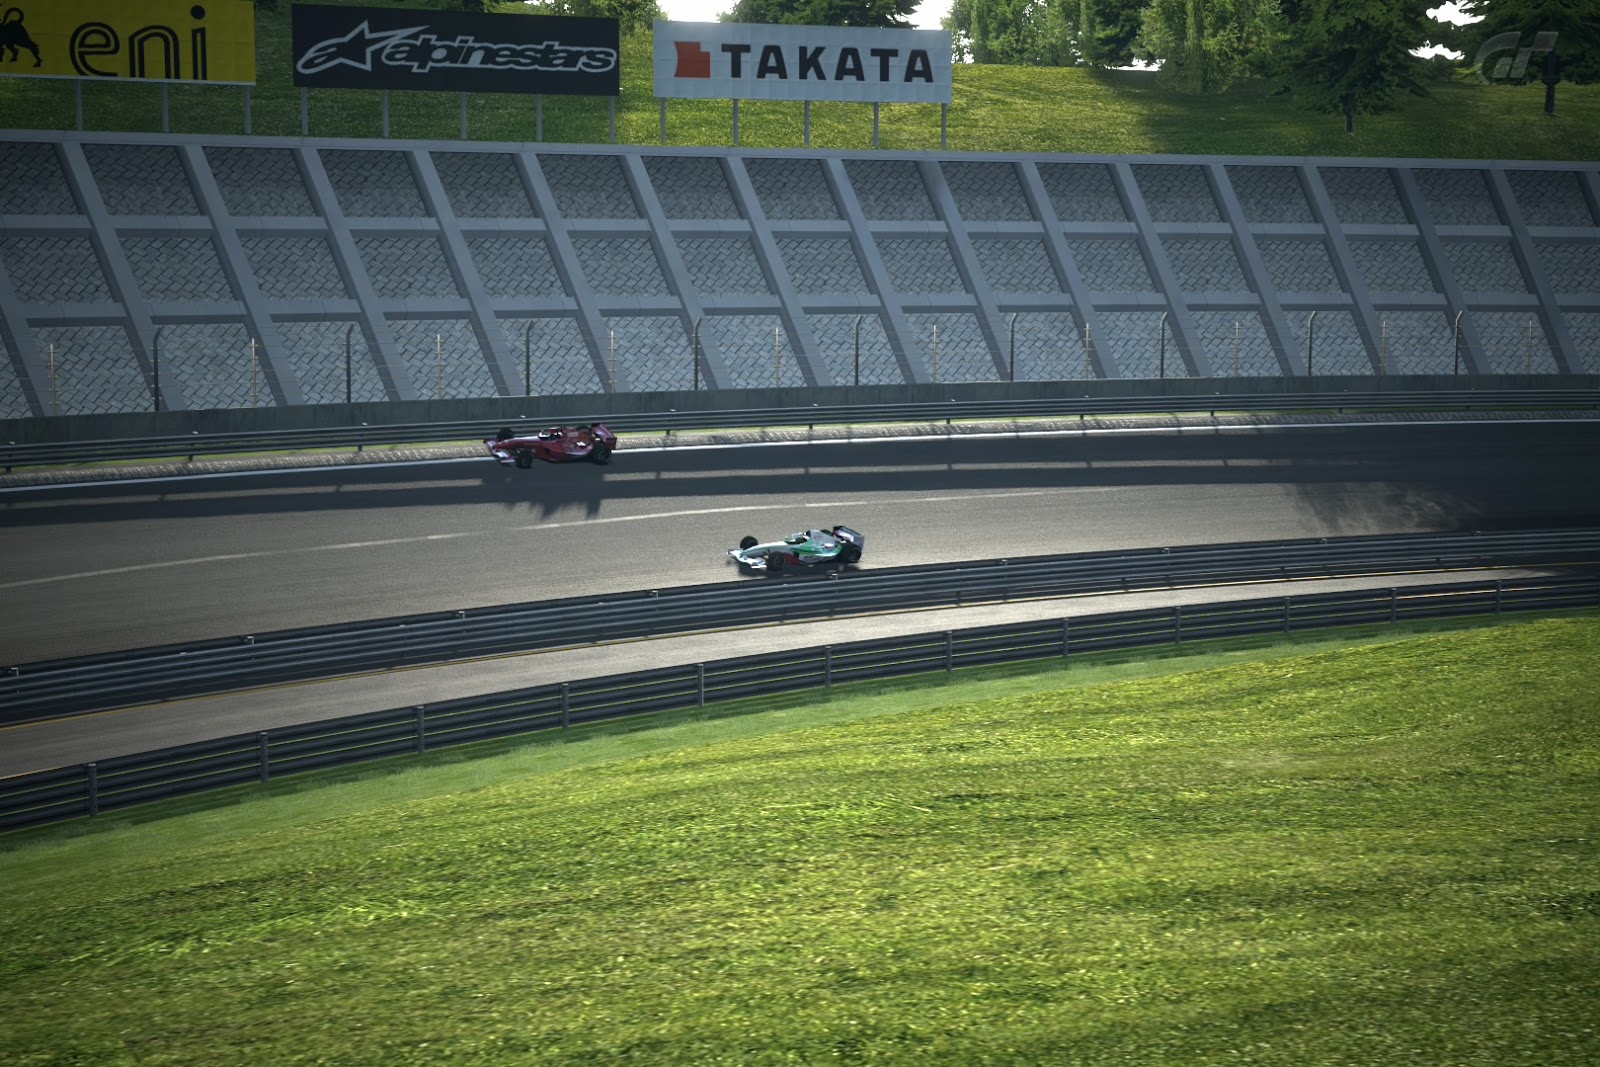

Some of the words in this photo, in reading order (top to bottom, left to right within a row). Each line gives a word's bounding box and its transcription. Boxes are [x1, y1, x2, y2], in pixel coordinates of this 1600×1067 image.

[69, 4, 208, 80] eni
[386, 33, 617, 74] alpinestars
[720, 43, 935, 83] TAKATA
